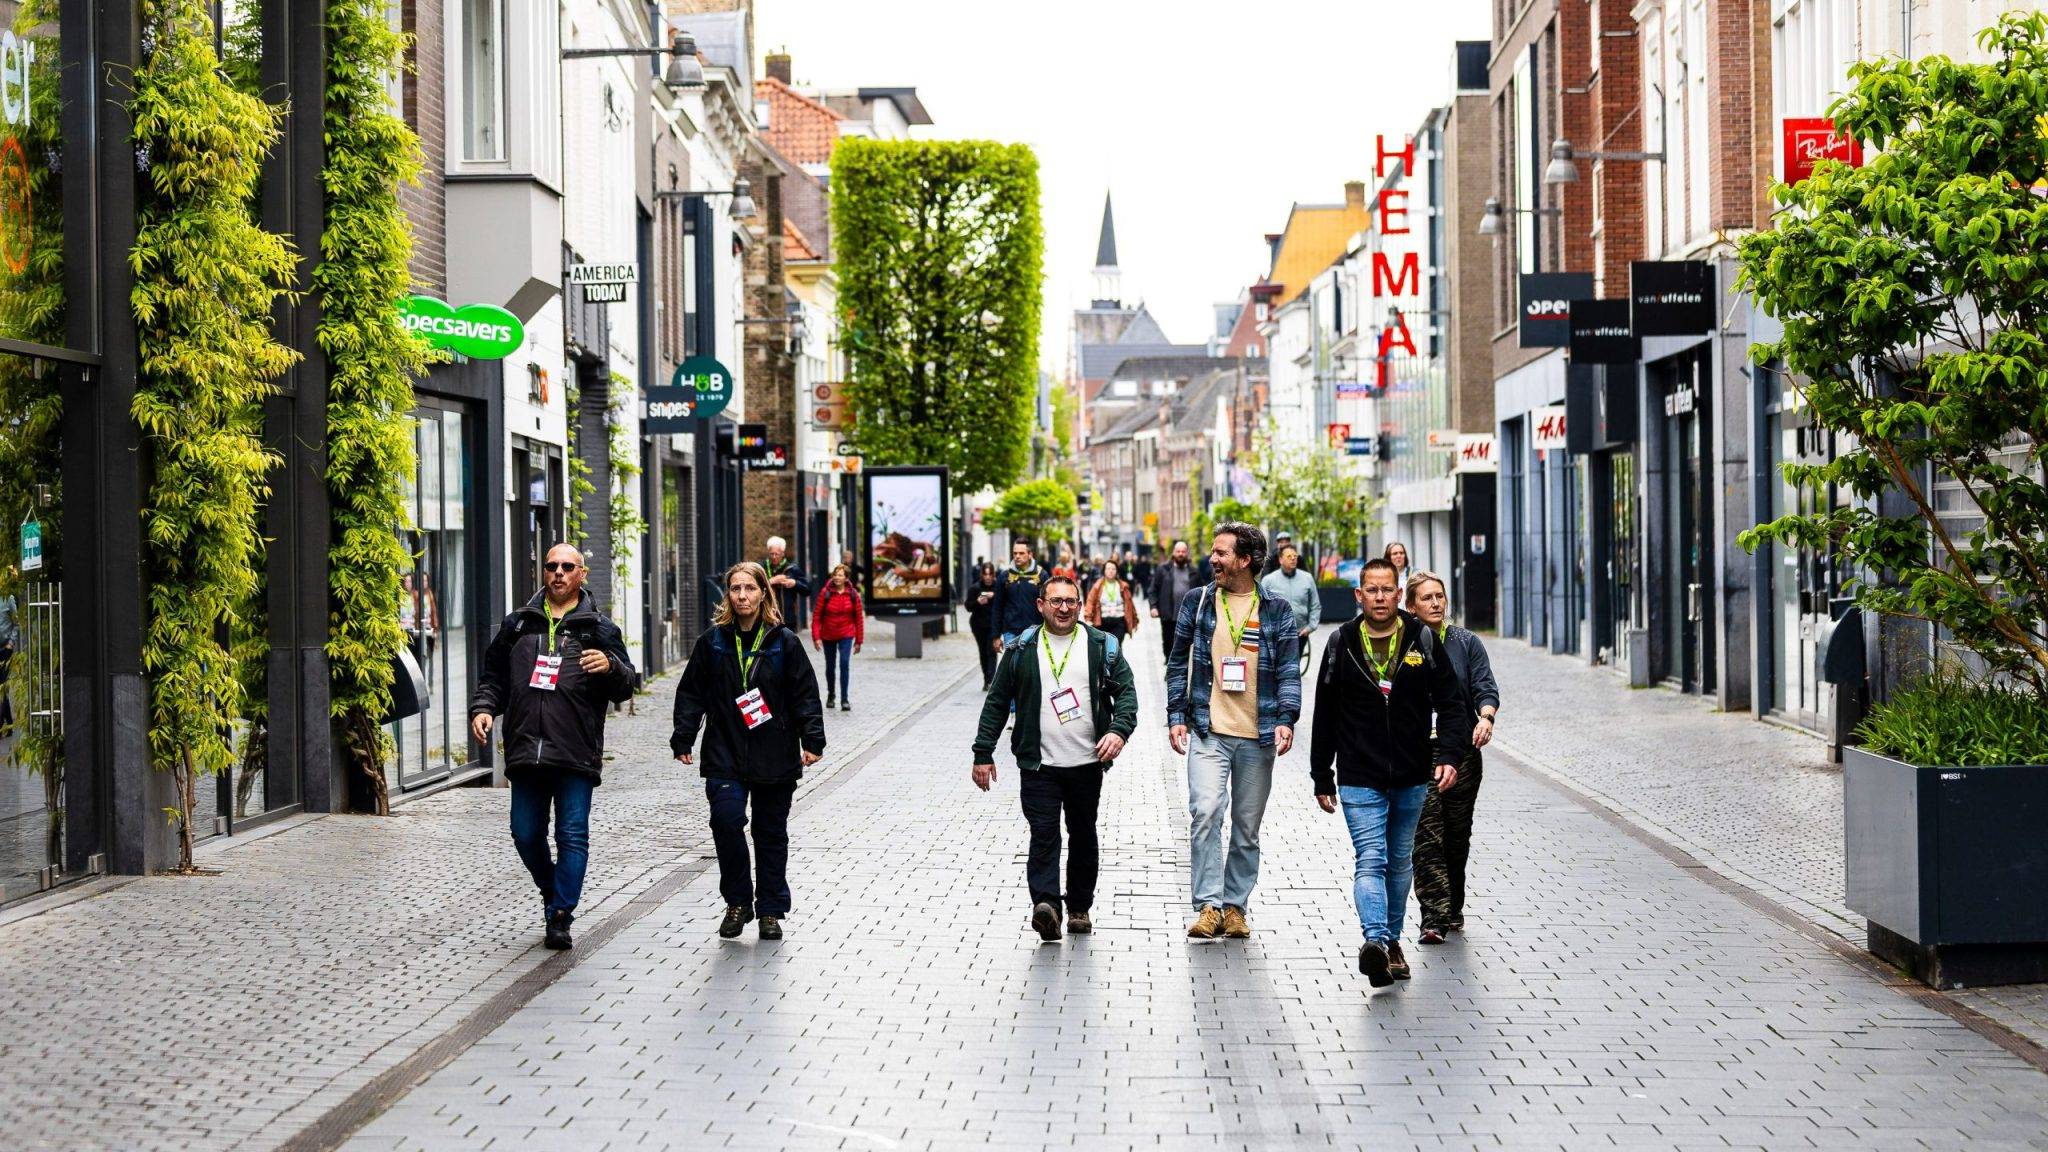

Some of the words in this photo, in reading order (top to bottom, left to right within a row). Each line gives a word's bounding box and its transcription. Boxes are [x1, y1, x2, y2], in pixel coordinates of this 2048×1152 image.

[1373, 134, 1419, 357] HEMA
[573, 265, 635, 281] AMERICA
[585, 284, 624, 301] TODAY
[396, 308, 512, 342] Specsavers
[649, 402, 691, 420] snipes
